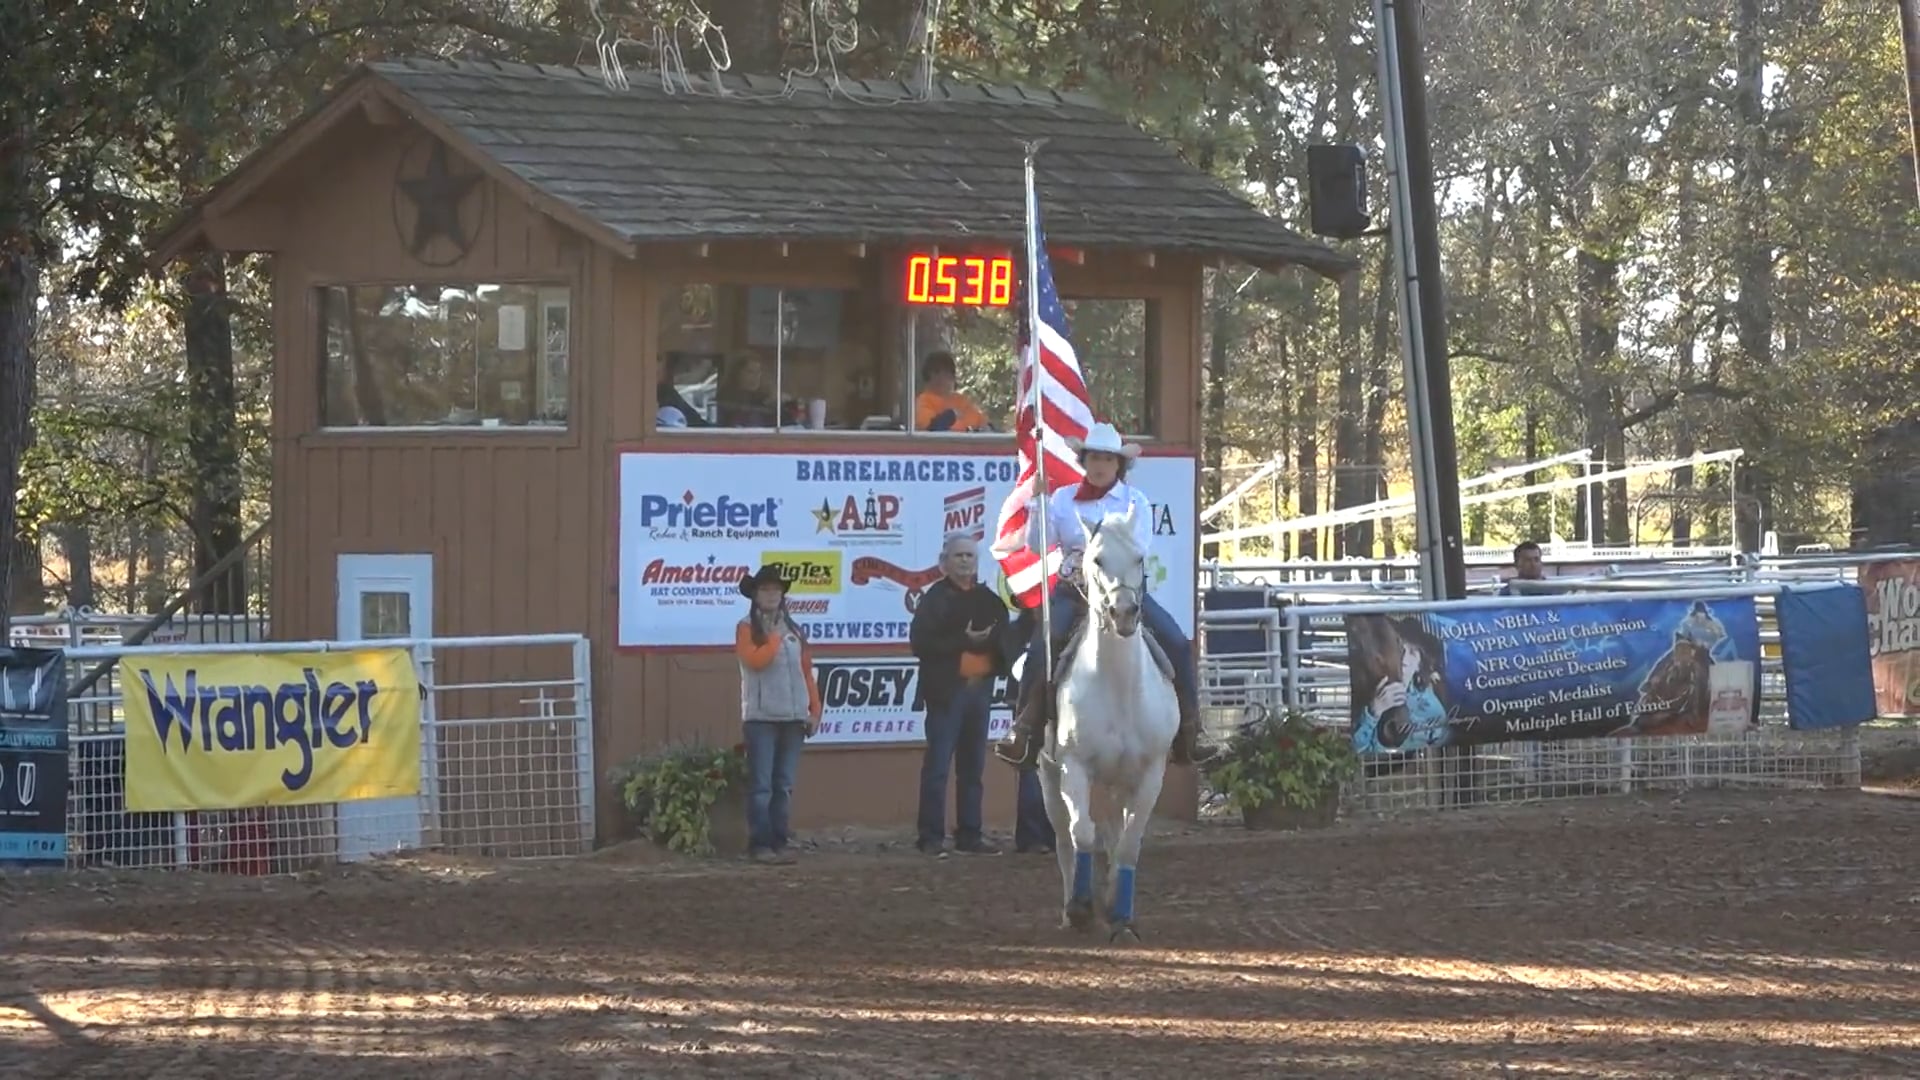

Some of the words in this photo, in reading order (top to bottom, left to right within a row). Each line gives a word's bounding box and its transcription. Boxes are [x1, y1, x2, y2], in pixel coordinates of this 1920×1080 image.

[641, 490, 779, 528] Priefert
[944, 502, 985, 532] MVP
[691, 528, 723, 538] Ranch
[726, 528, 780, 540] Equipment
[642, 558, 751, 586] American
[650, 587, 669, 597] HAT
[801, 621, 908, 639] OSEYWESTE
[1440, 622, 1490, 641] AQHA,
[1494, 613, 1545, 630] NBHA,
[1547, 609, 1560, 624] &
[1471, 635, 1519, 653] WPRA
[1523, 627, 1567, 645] World
[1570, 618, 1647, 638] Champion
[1464, 677, 1473, 691] 4
[1476, 665, 1564, 689] Consecutive
[1567, 656, 1628, 675] Decades
[1476, 656, 1510, 674] NFR
[1513, 648, 1578, 671] Qualifier
[1482, 694, 1546, 716] Olympic
[1549, 683, 1613, 704] Medalist
[140, 666, 378, 791] Wrangler
[819, 721, 843, 734] WE
[852, 720, 916, 734] CREATE
[1505, 711, 1568, 734] Multiple
[1570, 706, 1602, 723] Hall
[1606, 702, 1622, 717] of
[1625, 699, 1674, 716] Famer
